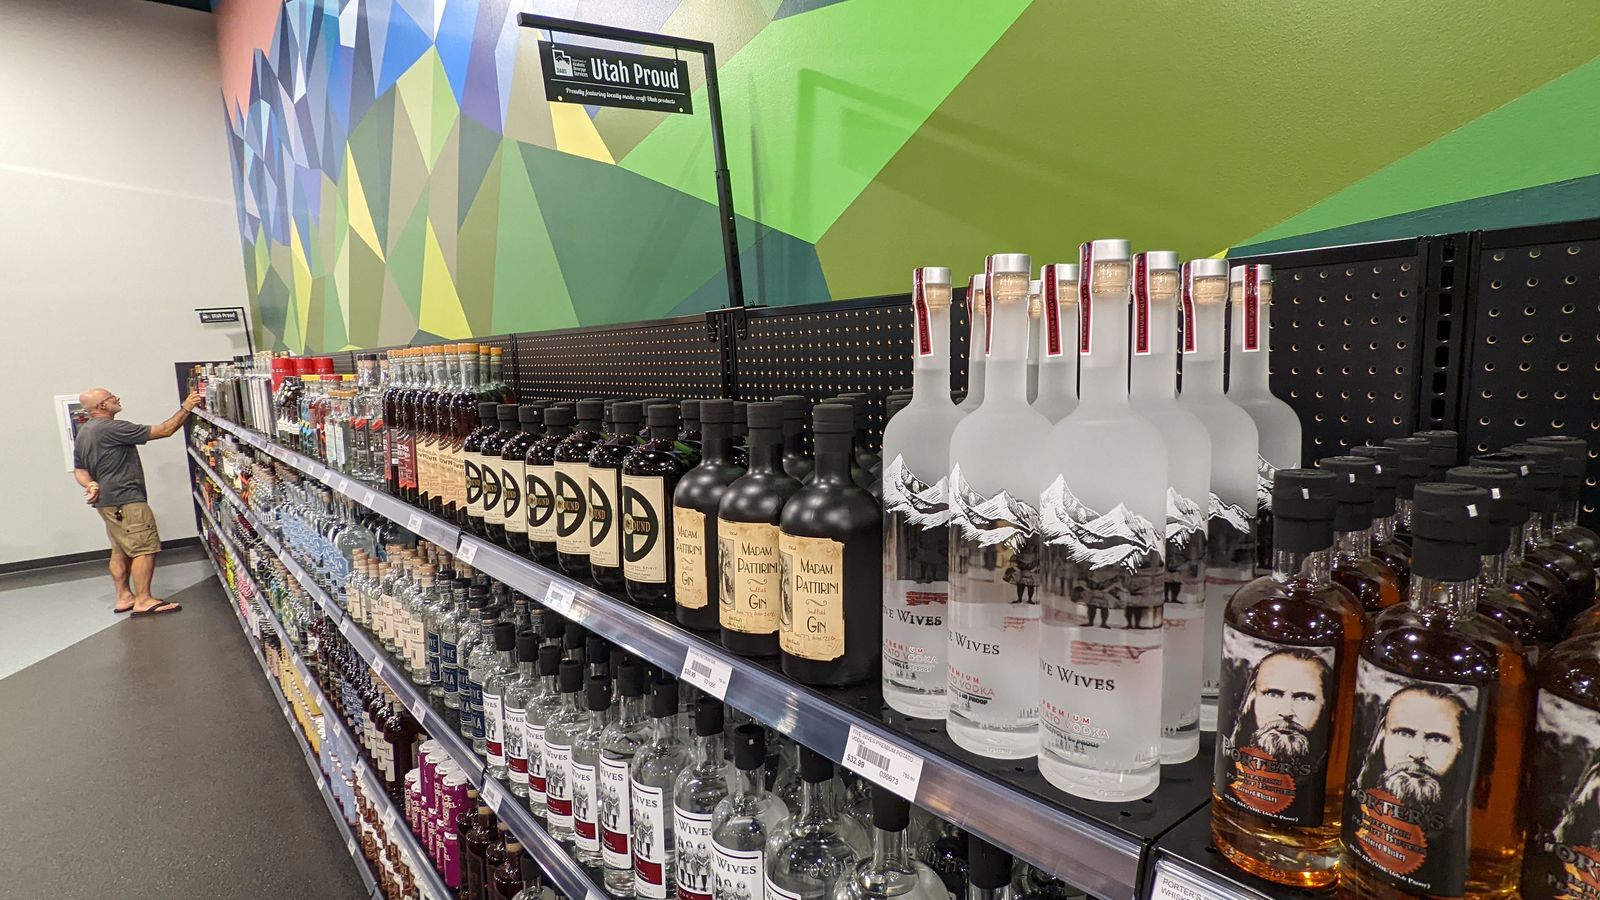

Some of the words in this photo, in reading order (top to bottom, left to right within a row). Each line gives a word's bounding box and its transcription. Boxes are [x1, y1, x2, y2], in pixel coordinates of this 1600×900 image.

[591, 58, 630, 83] Utah
[634, 63, 680, 89] Proud
[565, 87, 584, 96] Proudly
[584, 89, 606, 98] featuring
[606, 91, 622, 100] locally
[677, 525, 698, 539] MADAM
[741, 541, 773, 556] MADAM
[737, 557, 778, 574] PATTIRINI
[800, 558, 833, 575] MADAM
[681, 571, 694, 587] GIN
[796, 575, 839, 595] PATTIRINI
[748, 593, 767, 610] GIN
[807, 616, 826, 633] GIN
[896, 608, 943, 626] WIVES
[955, 631, 1000, 655] WIVES
[1056, 665, 1116, 691] WIVES
[959, 680, 995, 697] VODKA
[1064, 720, 1110, 740] VODKA
[851, 735, 866, 746] VODKA
[875, 738, 896, 754] PREMIUM
[895, 749, 914, 763] POTATO
[1221, 733, 1312, 777] PORTER'S
[846, 753, 866, 769] $32.99
[879, 770, 899, 786] 036673
[716, 855, 757, 875] WIVES
[1162, 878, 1203, 900] PORTER'S
